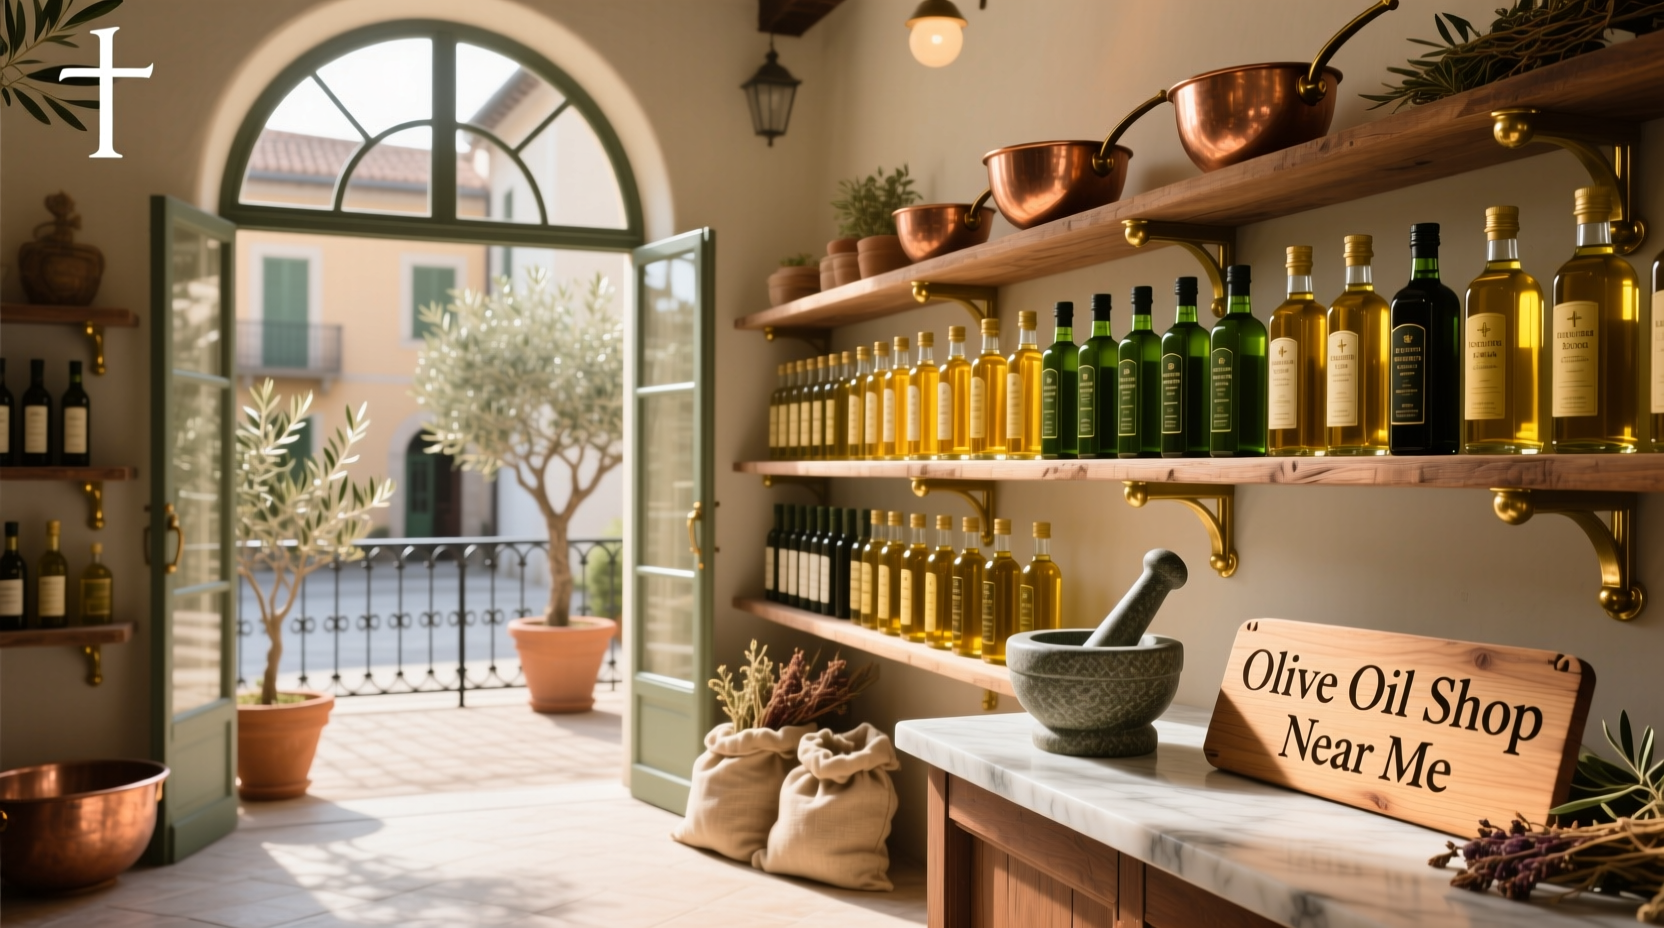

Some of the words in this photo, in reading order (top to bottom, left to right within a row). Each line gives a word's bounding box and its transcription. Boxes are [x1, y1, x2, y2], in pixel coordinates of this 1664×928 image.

[1242, 648, 1337, 704] Olive
[1348, 664, 1415, 718] Oil
[1422, 676, 1543, 756] Shop
[1278, 713, 1374, 775] Near
[1378, 735, 1452, 793] Me
